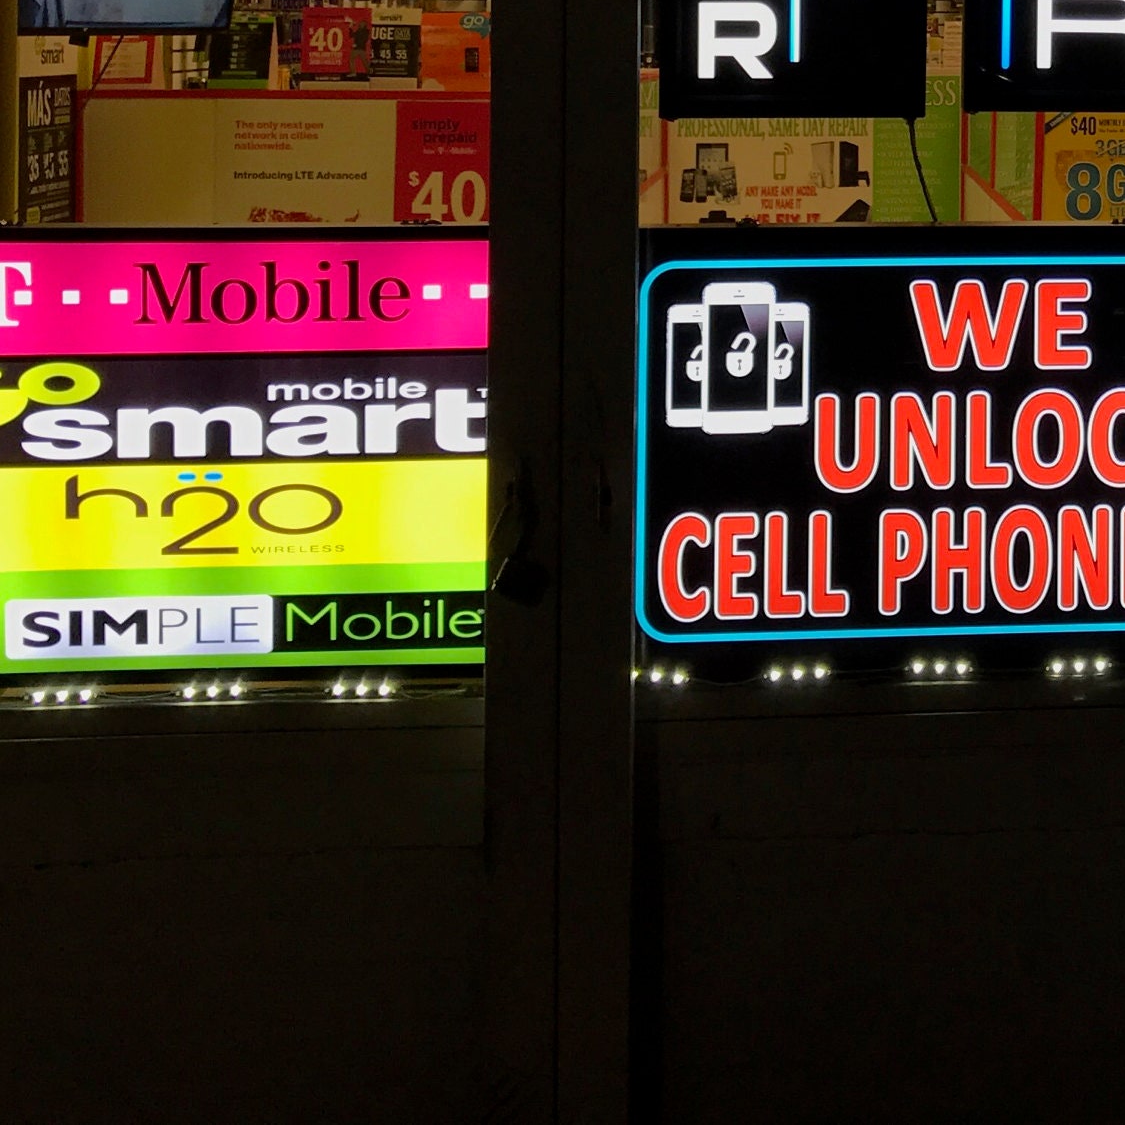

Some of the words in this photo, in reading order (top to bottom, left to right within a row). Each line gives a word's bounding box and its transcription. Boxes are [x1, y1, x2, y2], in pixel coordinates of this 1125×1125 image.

[234, 132, 277, 140] network
[412, 119, 460, 133] simply
[768, 118, 800, 137] SAME
[803, 118, 825, 137] DAY
[828, 118, 868, 137] REPAIR
[1071, 116, 1097, 135] $40
[423, 131, 477, 146] prepaid
[233, 171, 294, 182] Introducing
[295, 171, 314, 180] LTE
[316, 171, 368, 181] Advanced
[407, 170, 488, 222] $40
[133, 260, 411, 325] Mobile
[909, 279, 1092, 371] WE
[266, 377, 427, 402] mobile
[21, 389, 487, 461] smart
[250, 544, 346, 554] WIRELESS
[657, 510, 850, 623] CELL
[22, 605, 260, 648] SIMPLE
[286, 599, 483, 642] Mobile
